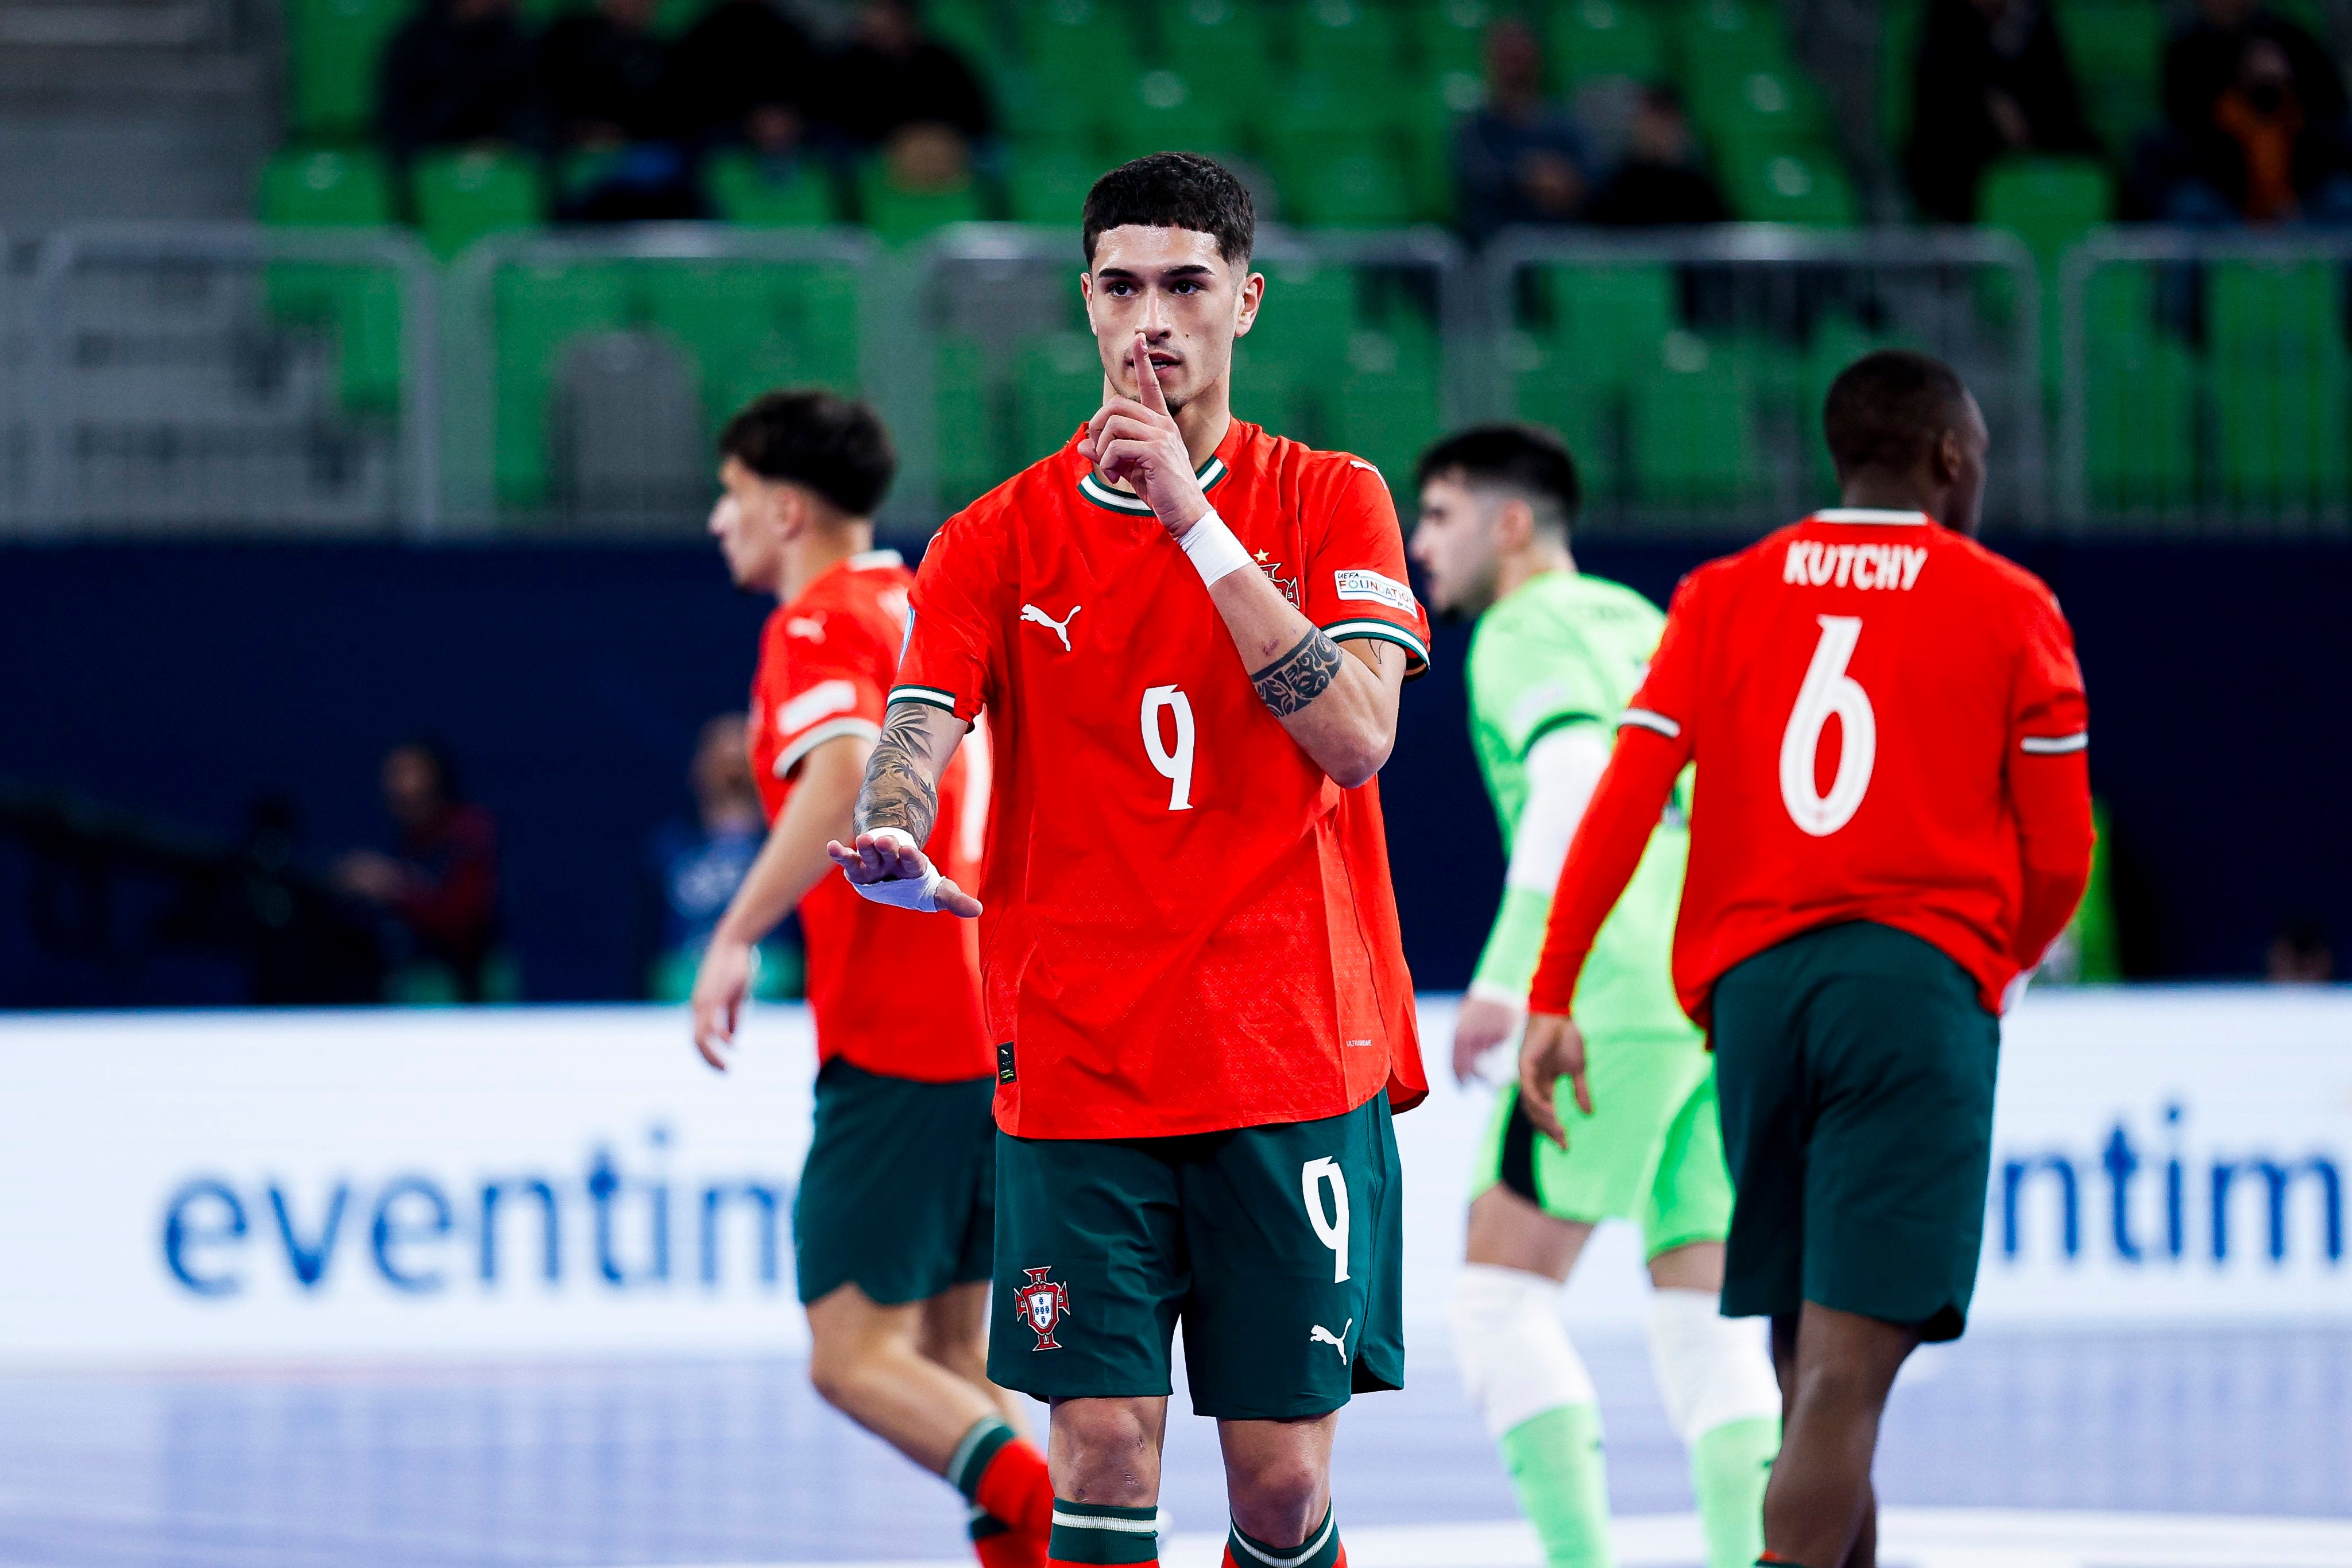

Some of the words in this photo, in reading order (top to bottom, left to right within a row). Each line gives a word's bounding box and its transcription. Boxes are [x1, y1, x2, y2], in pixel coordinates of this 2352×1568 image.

[1784, 541, 1928, 591] KUTCHY
[1141, 684, 1196, 811] 9
[1779, 614, 1876, 837] 6
[1302, 1156, 1351, 1284] 9
[2002, 1104, 2343, 1263] ntim
